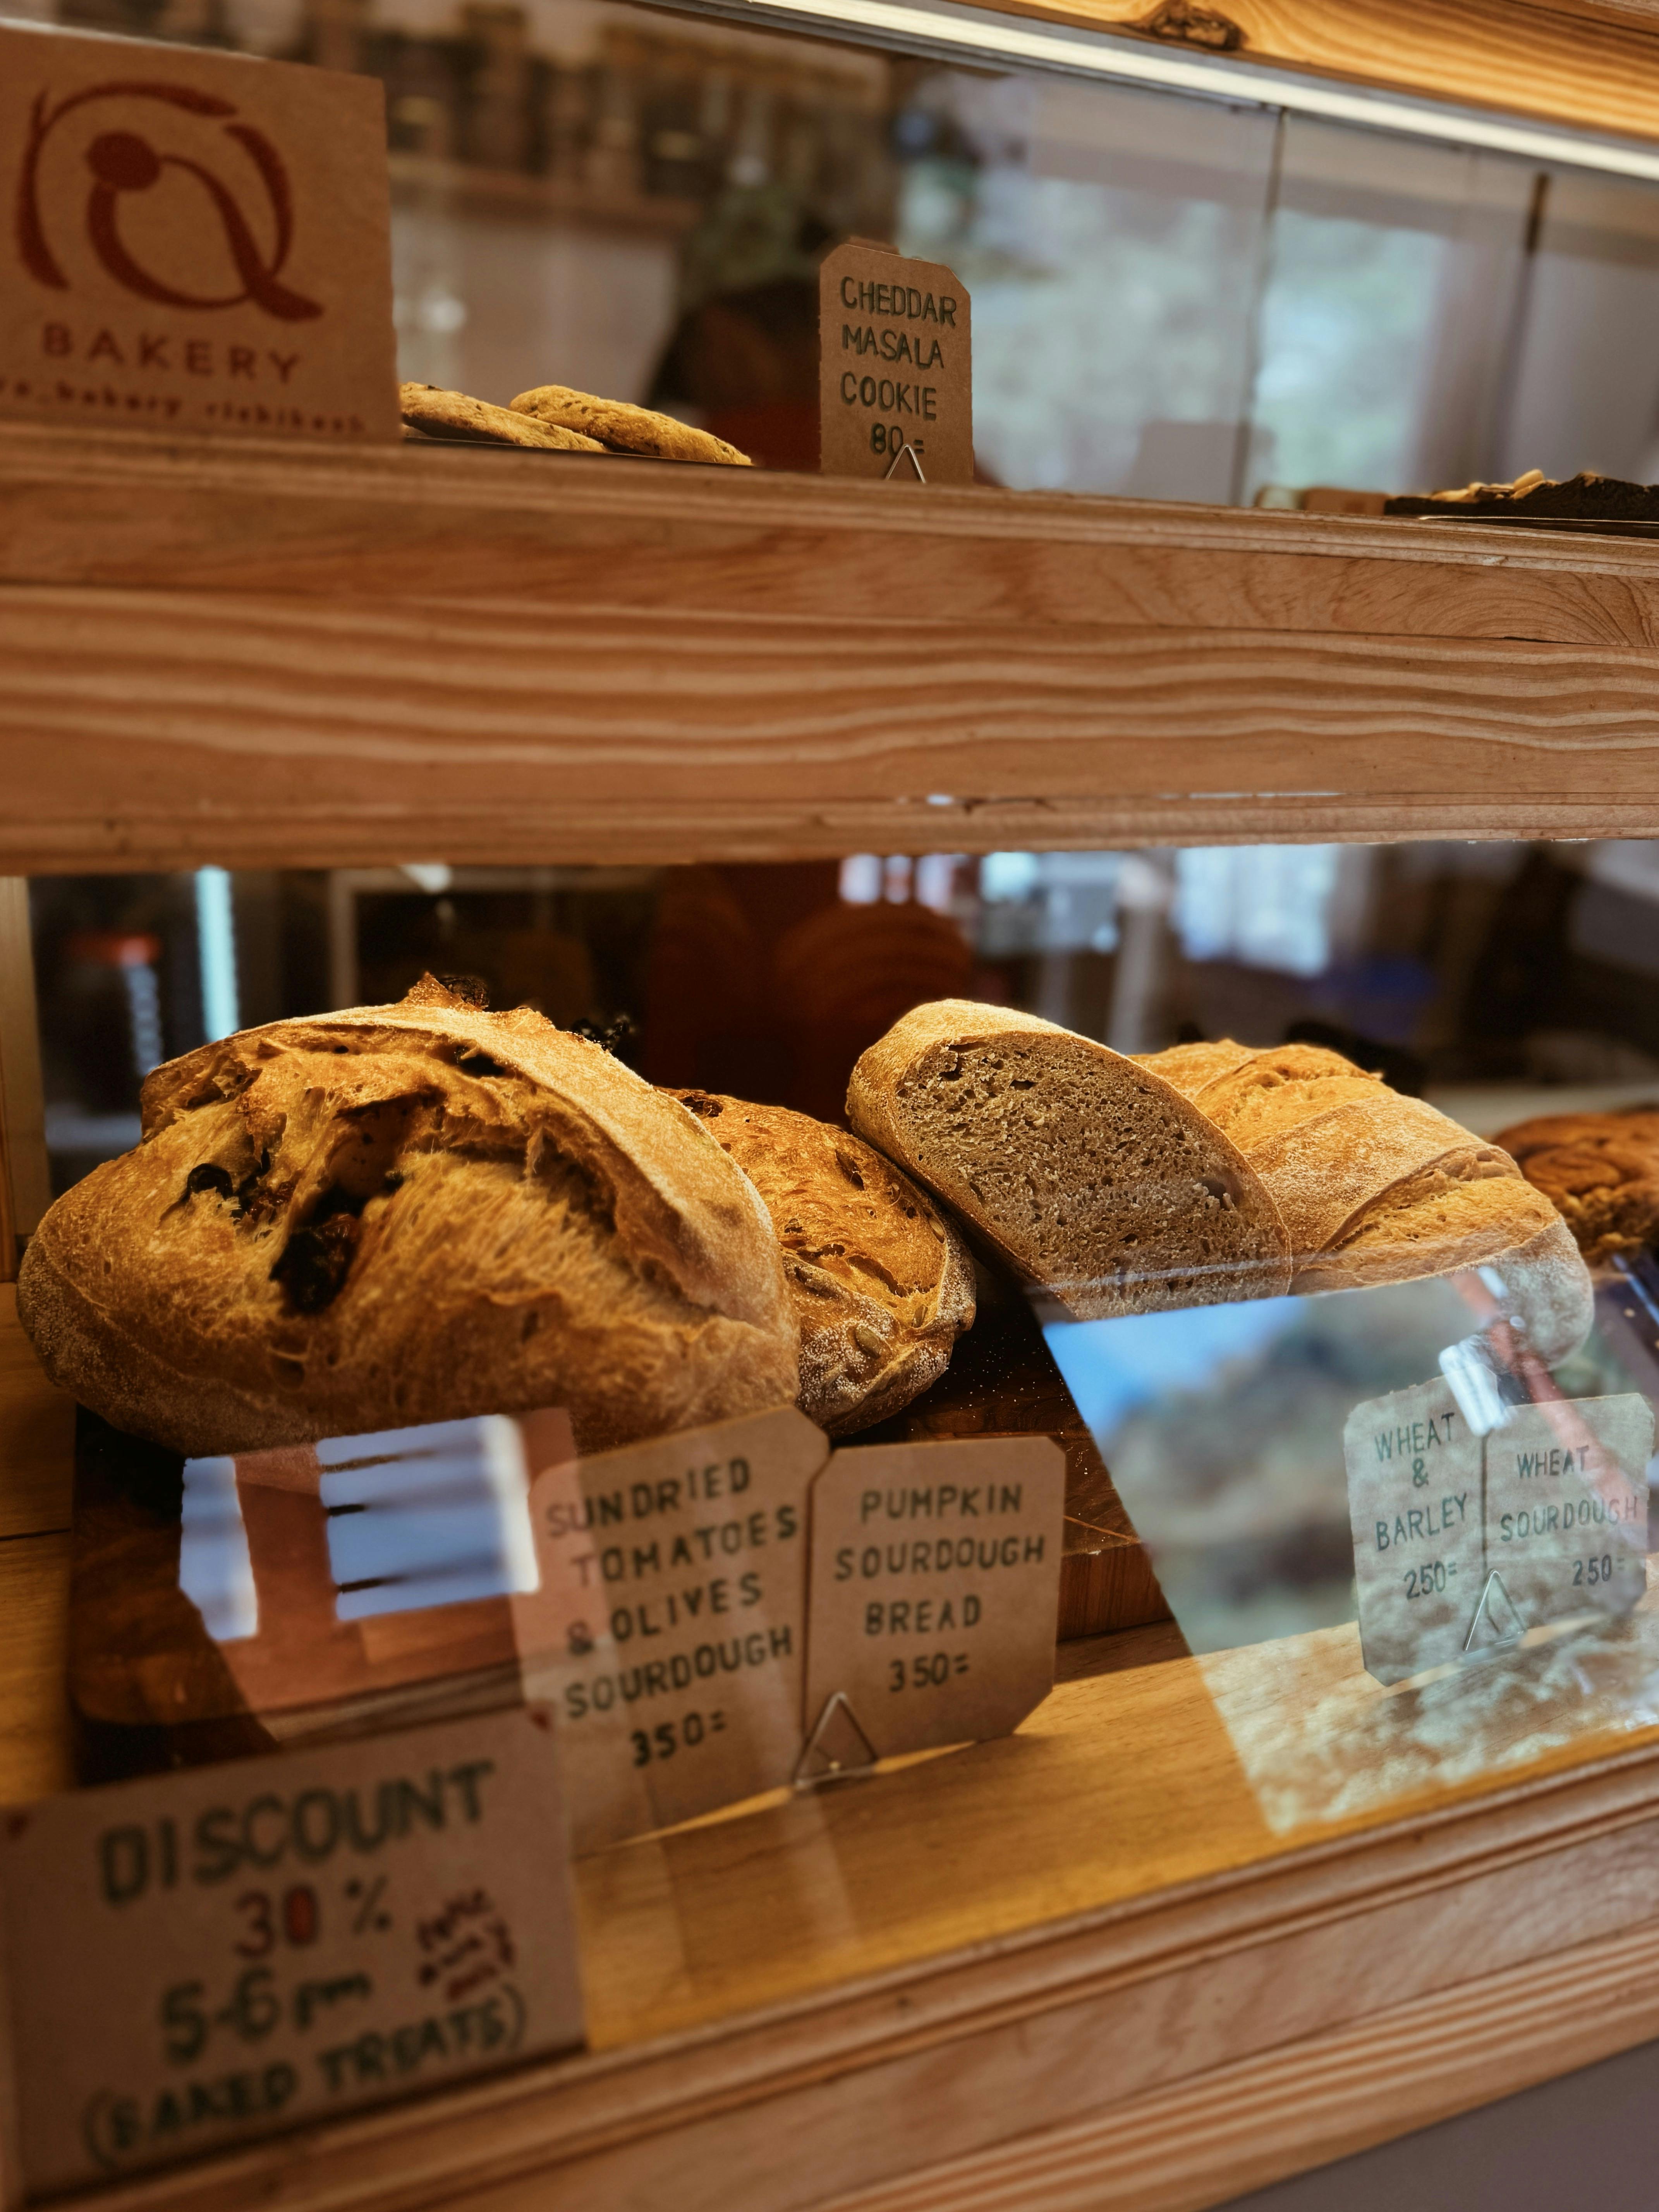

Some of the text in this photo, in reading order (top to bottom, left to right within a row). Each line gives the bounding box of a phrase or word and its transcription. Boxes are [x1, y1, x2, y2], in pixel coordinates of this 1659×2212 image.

[840, 276, 957, 327] CHEDDAR
[43, 323, 299, 383] BAKERY
[842, 324, 944, 370] MASALA
[841, 371, 937, 421] COOKIE
[1374, 1412, 1455, 1462] WHEAT
[1516, 1445, 1589, 1479] WHEAT
[546, 1456, 751, 1539] SUNDRIED
[1412, 1458, 1429, 1488] &
[860, 1483, 1022, 1525] PUMPKIN
[1376, 1492, 1468, 1551] BARLEY
[1500, 1495, 1638, 1543] SOURDOUGH
[570, 1505, 798, 1587] TOMATOES
[834, 1535, 1046, 1582] SOURDOUGH
[567, 1571, 763, 1656] & OLIVES
[864, 1594, 981, 1636] BREAD
[565, 1625, 793, 1719] SOURDOUGH
[98, 1758, 496, 1907] DISCOUNT
